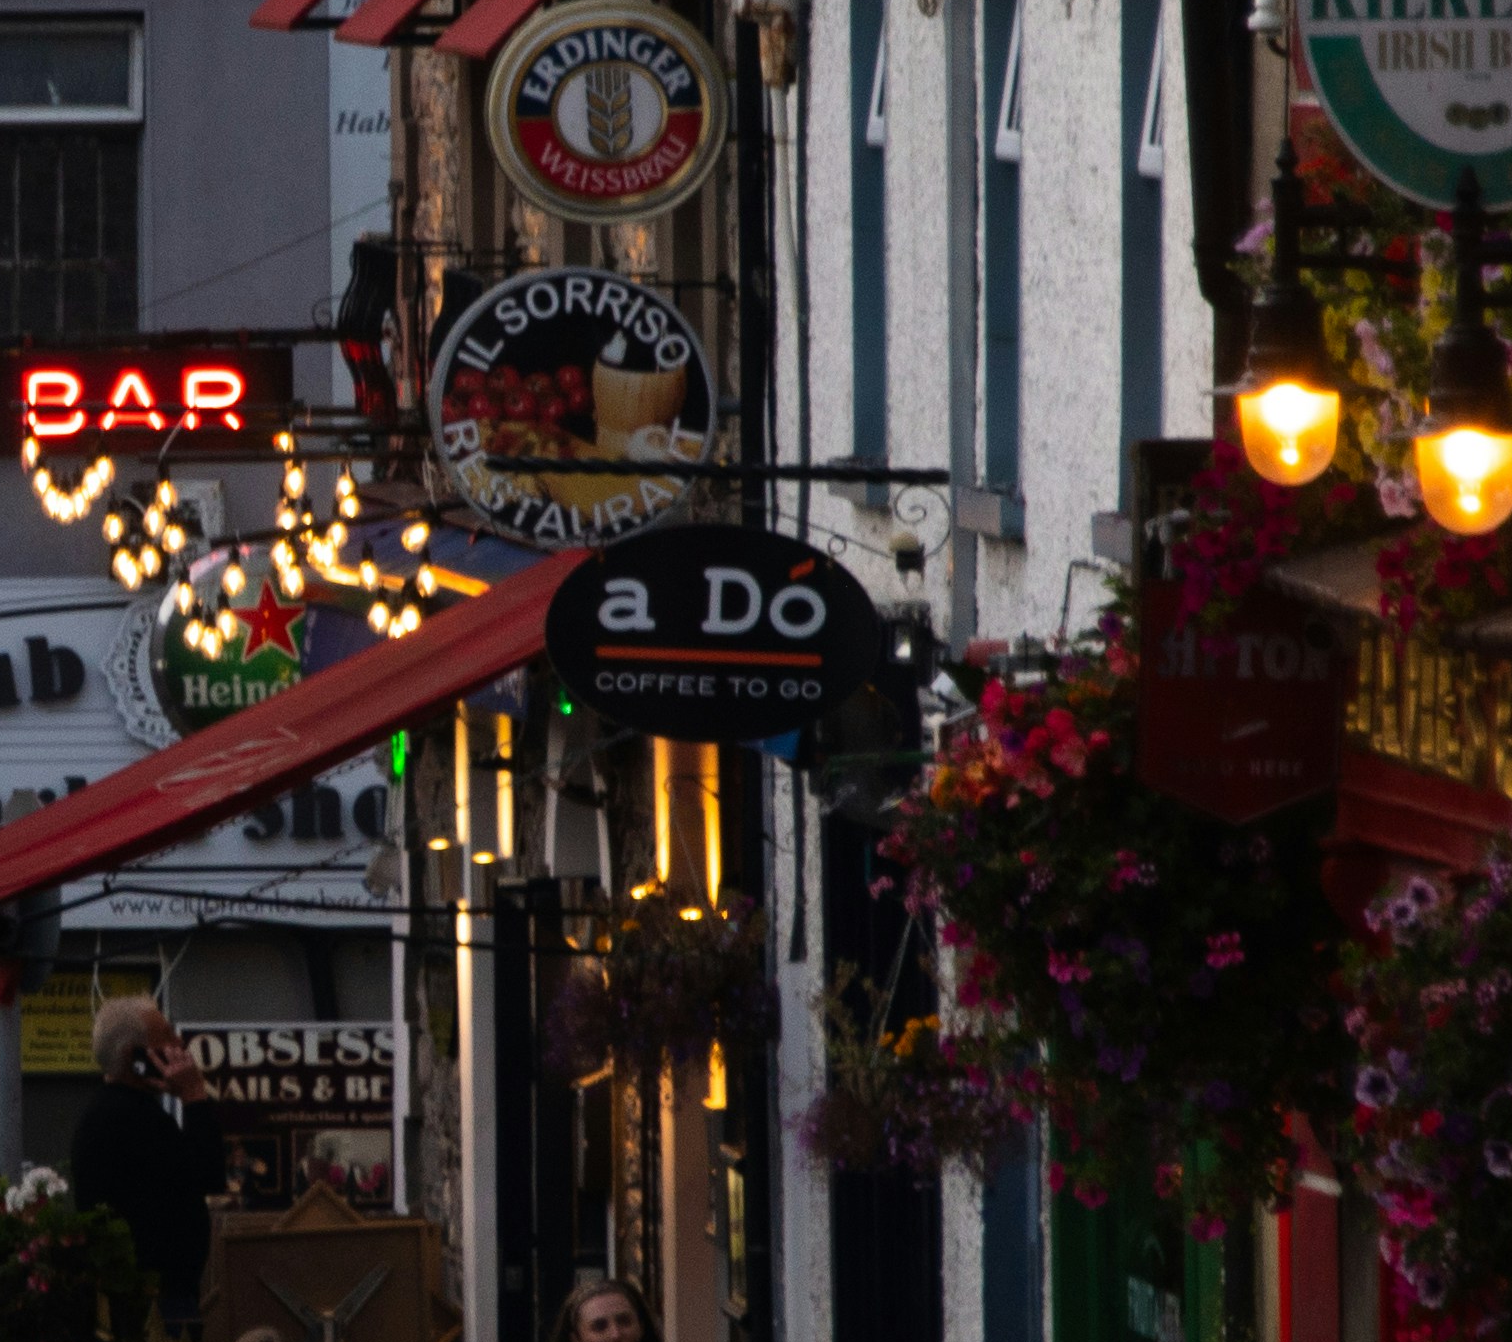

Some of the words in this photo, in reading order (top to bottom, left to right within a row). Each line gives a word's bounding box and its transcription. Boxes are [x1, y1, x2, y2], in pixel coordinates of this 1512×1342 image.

[522, 29, 692, 105] ERDINGER
[1377, 30, 1474, 72] IRISH
[457, 333, 505, 373] IL
[493, 275, 693, 372] SORRISO
[19, 366, 248, 439] BAR
[597, 577, 656, 632] a
[182, 672, 304, 708] Heine
[595, 671, 718, 697] COFFEE
[728, 674, 769, 697] TO
[779, 677, 823, 701] GO
[312, 1075, 335, 1102] &
